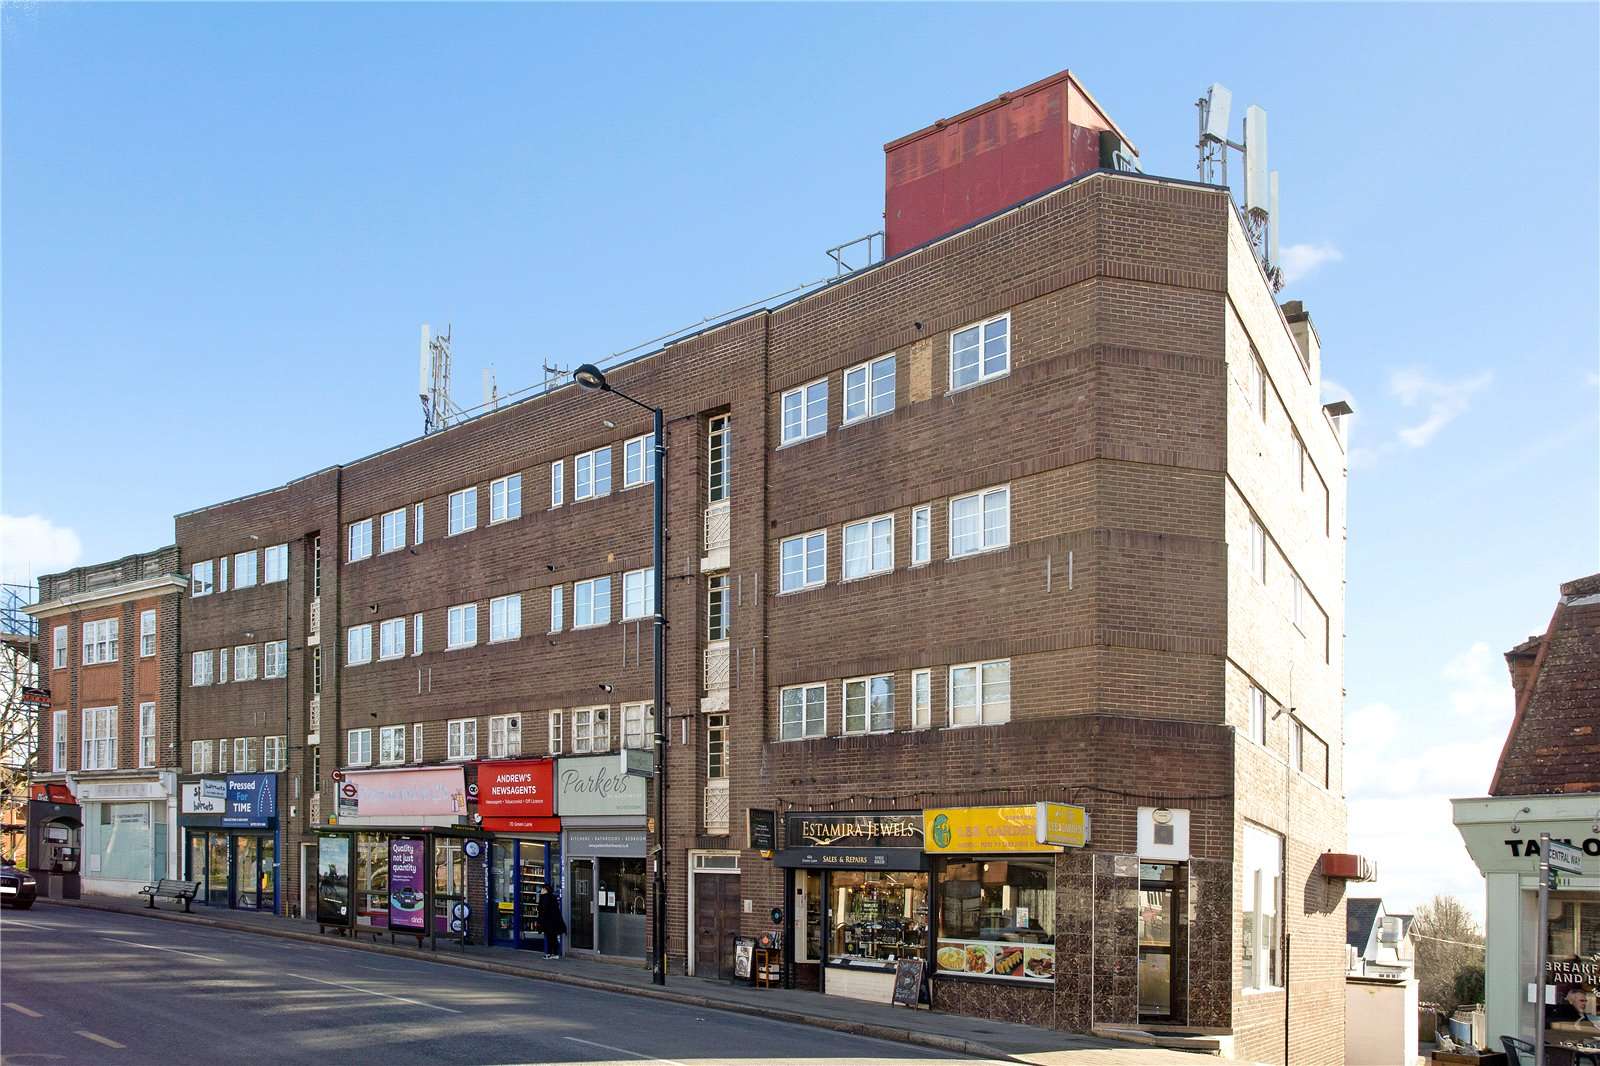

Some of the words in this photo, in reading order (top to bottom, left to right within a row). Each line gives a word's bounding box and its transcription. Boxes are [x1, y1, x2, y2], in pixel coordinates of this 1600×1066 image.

[496, 773, 532, 783] ANDREW'S
[561, 767, 630, 798] Parkers
[229, 781, 256, 790] Pressed
[491, 786, 537, 795] NEWSAGENTS
[236, 792, 249, 801] For
[233, 803, 252, 813] TIME
[392, 844, 414, 854] Quality
[1504, 838, 1600, 857] TAO
[402, 855, 414, 864] just
[1549, 848, 1570, 864] CENTRAL
[1570, 855, 1581, 865] WAY
[392, 863, 417, 874] quantity
[1554, 973, 1583, 984] AND
[1588, 975, 1600, 985] H
